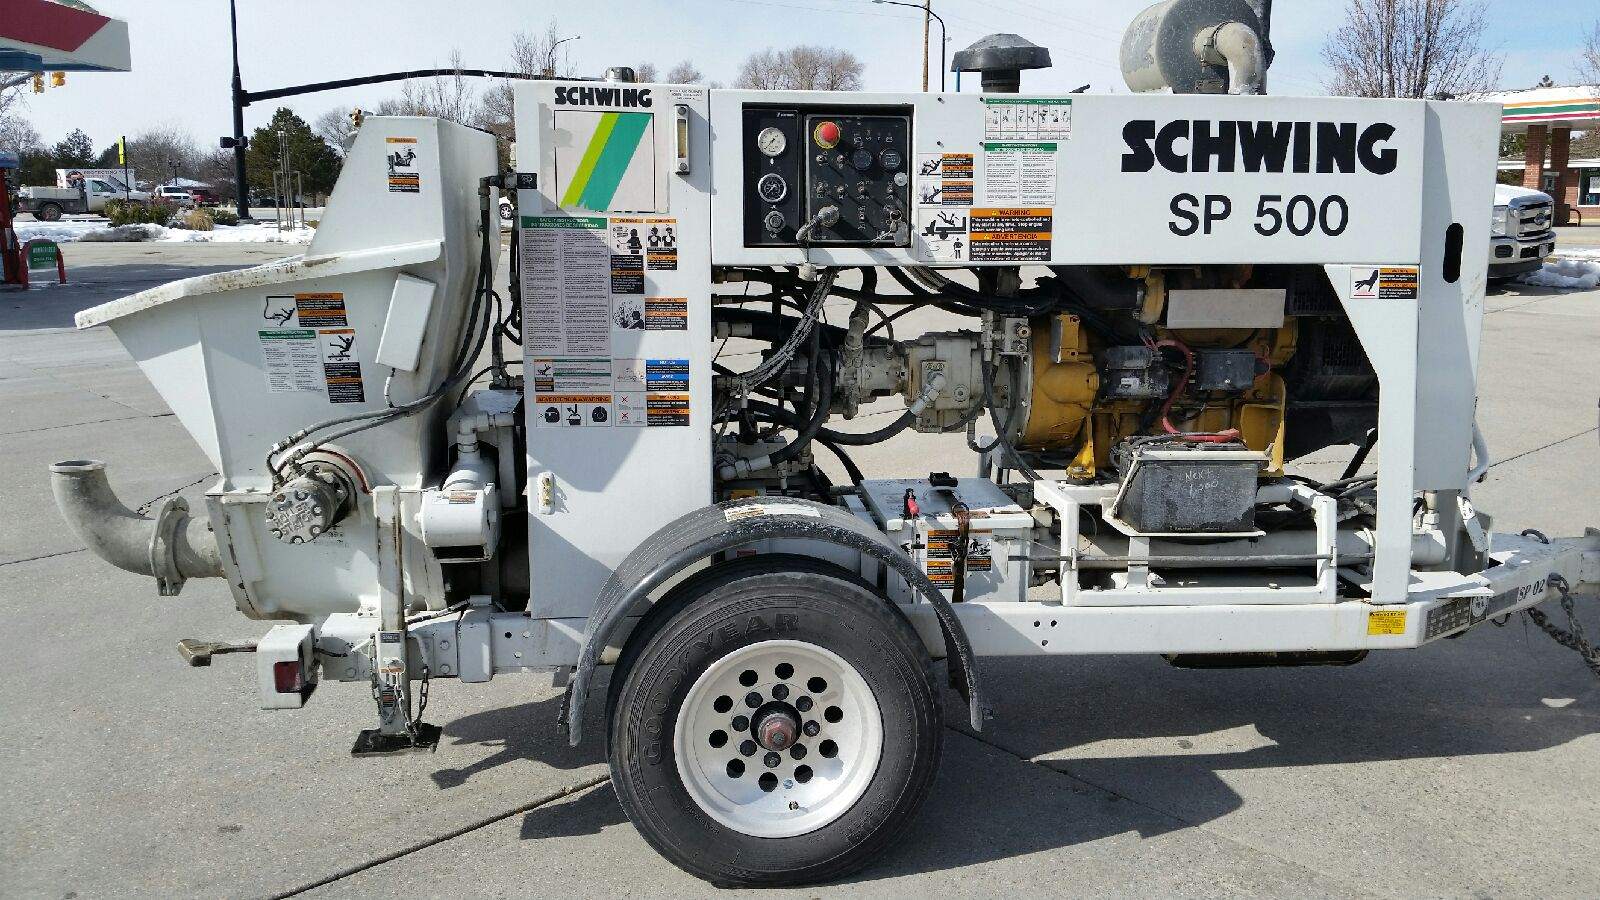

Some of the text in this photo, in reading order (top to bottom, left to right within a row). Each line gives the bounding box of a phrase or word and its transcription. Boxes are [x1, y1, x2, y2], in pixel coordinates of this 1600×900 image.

[554, 86, 653, 108] SCHWING
[1121, 119, 1398, 175] SCHWING
[1168, 193, 1349, 237] SP 500
[1518, 584, 1532, 601] SP
[642, 612, 800, 766] GOODYEAR
